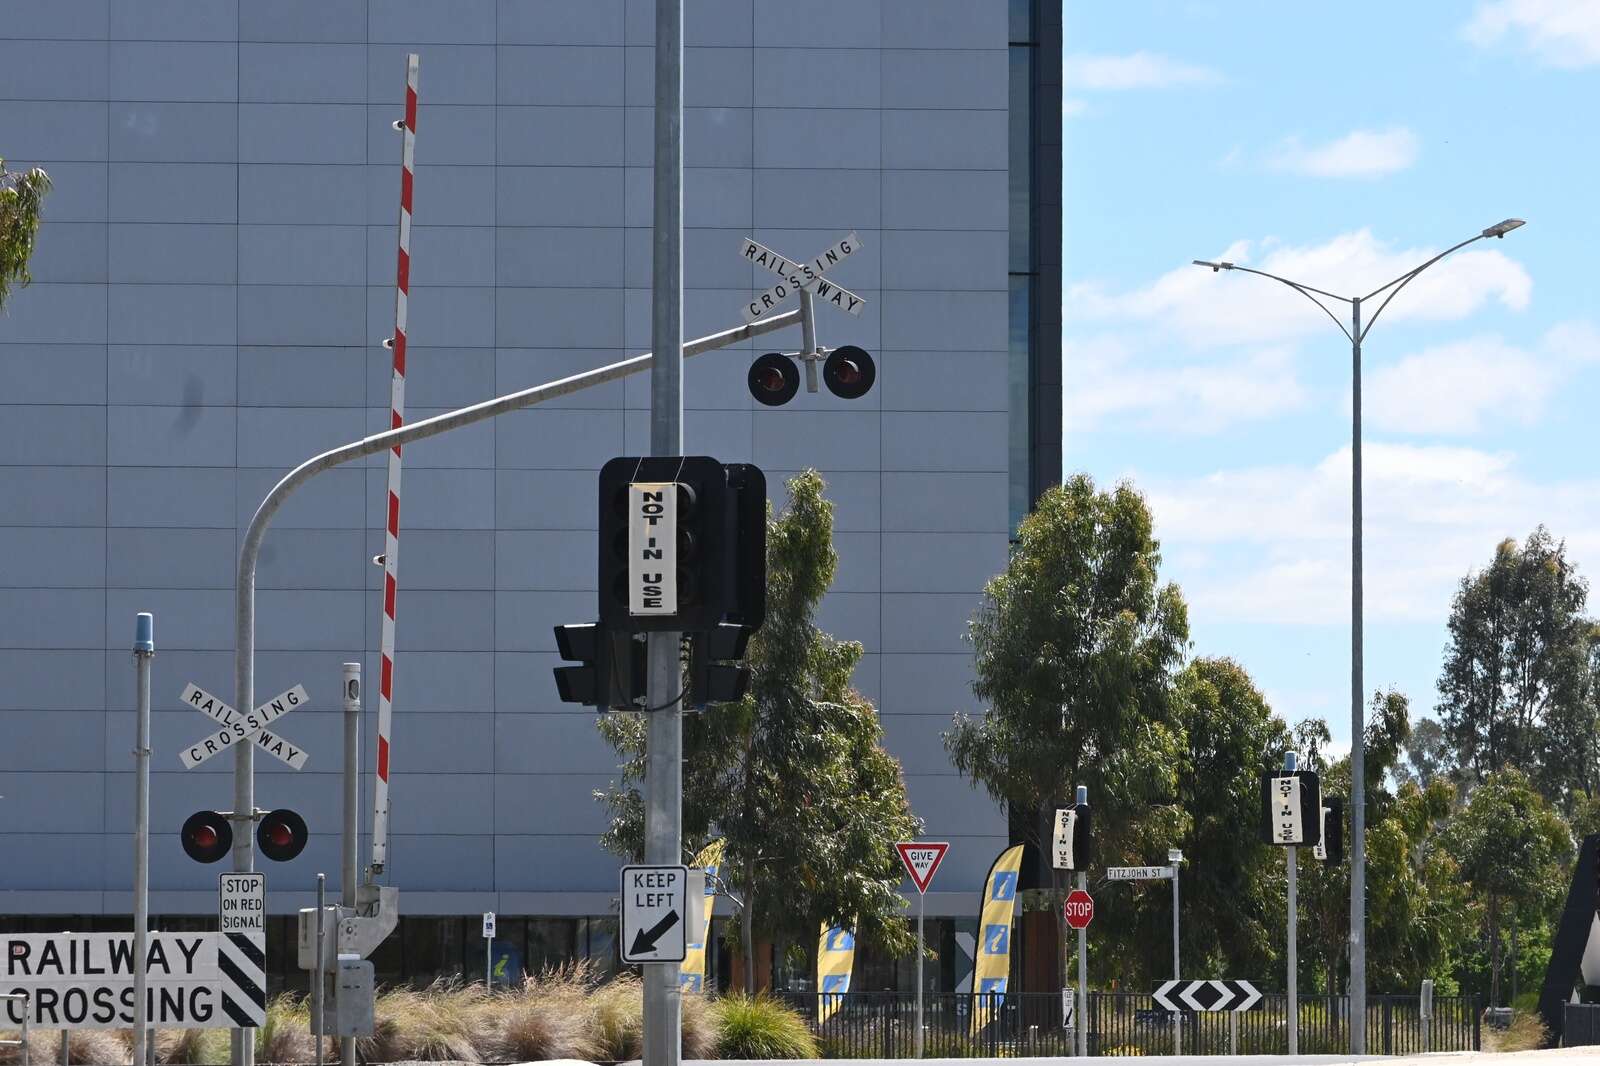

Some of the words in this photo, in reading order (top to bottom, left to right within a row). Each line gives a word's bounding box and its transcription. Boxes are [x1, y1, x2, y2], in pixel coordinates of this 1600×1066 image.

[745, 244, 785, 276] RAIL
[817, 281, 858, 311] WAY
[750, 241, 851, 316] CROSSING
[642, 492, 664, 525] NOT
[643, 537, 662, 560] IN
[642, 573, 663, 608] USE
[190, 691, 231, 725] RAIL
[258, 731, 298, 761] WAY
[190, 692, 298, 762] CROSSING
[1280, 780, 1292, 797] NOT
[1281, 805, 1292, 816] IN
[1061, 811, 1070, 828] NOT
[1059, 834, 1066, 845] IN
[1282, 823, 1294, 841] USE
[910, 851, 933, 861] GIVE
[634, 873, 676, 888] KEEP
[1108, 868, 1148, 878] FITZJOHN
[1151, 868, 1161, 877] ST
[226, 879, 259, 893] STOP
[223, 899, 238, 910] ON
[240, 899, 262, 910] RED
[636, 893, 674, 907] LEFT
[1066, 902, 1092, 917] STOP
[223, 916, 262, 928] SIGNAL
[7, 939, 203, 975] RAILWAY
[6, 986, 213, 1024] CROSSING
